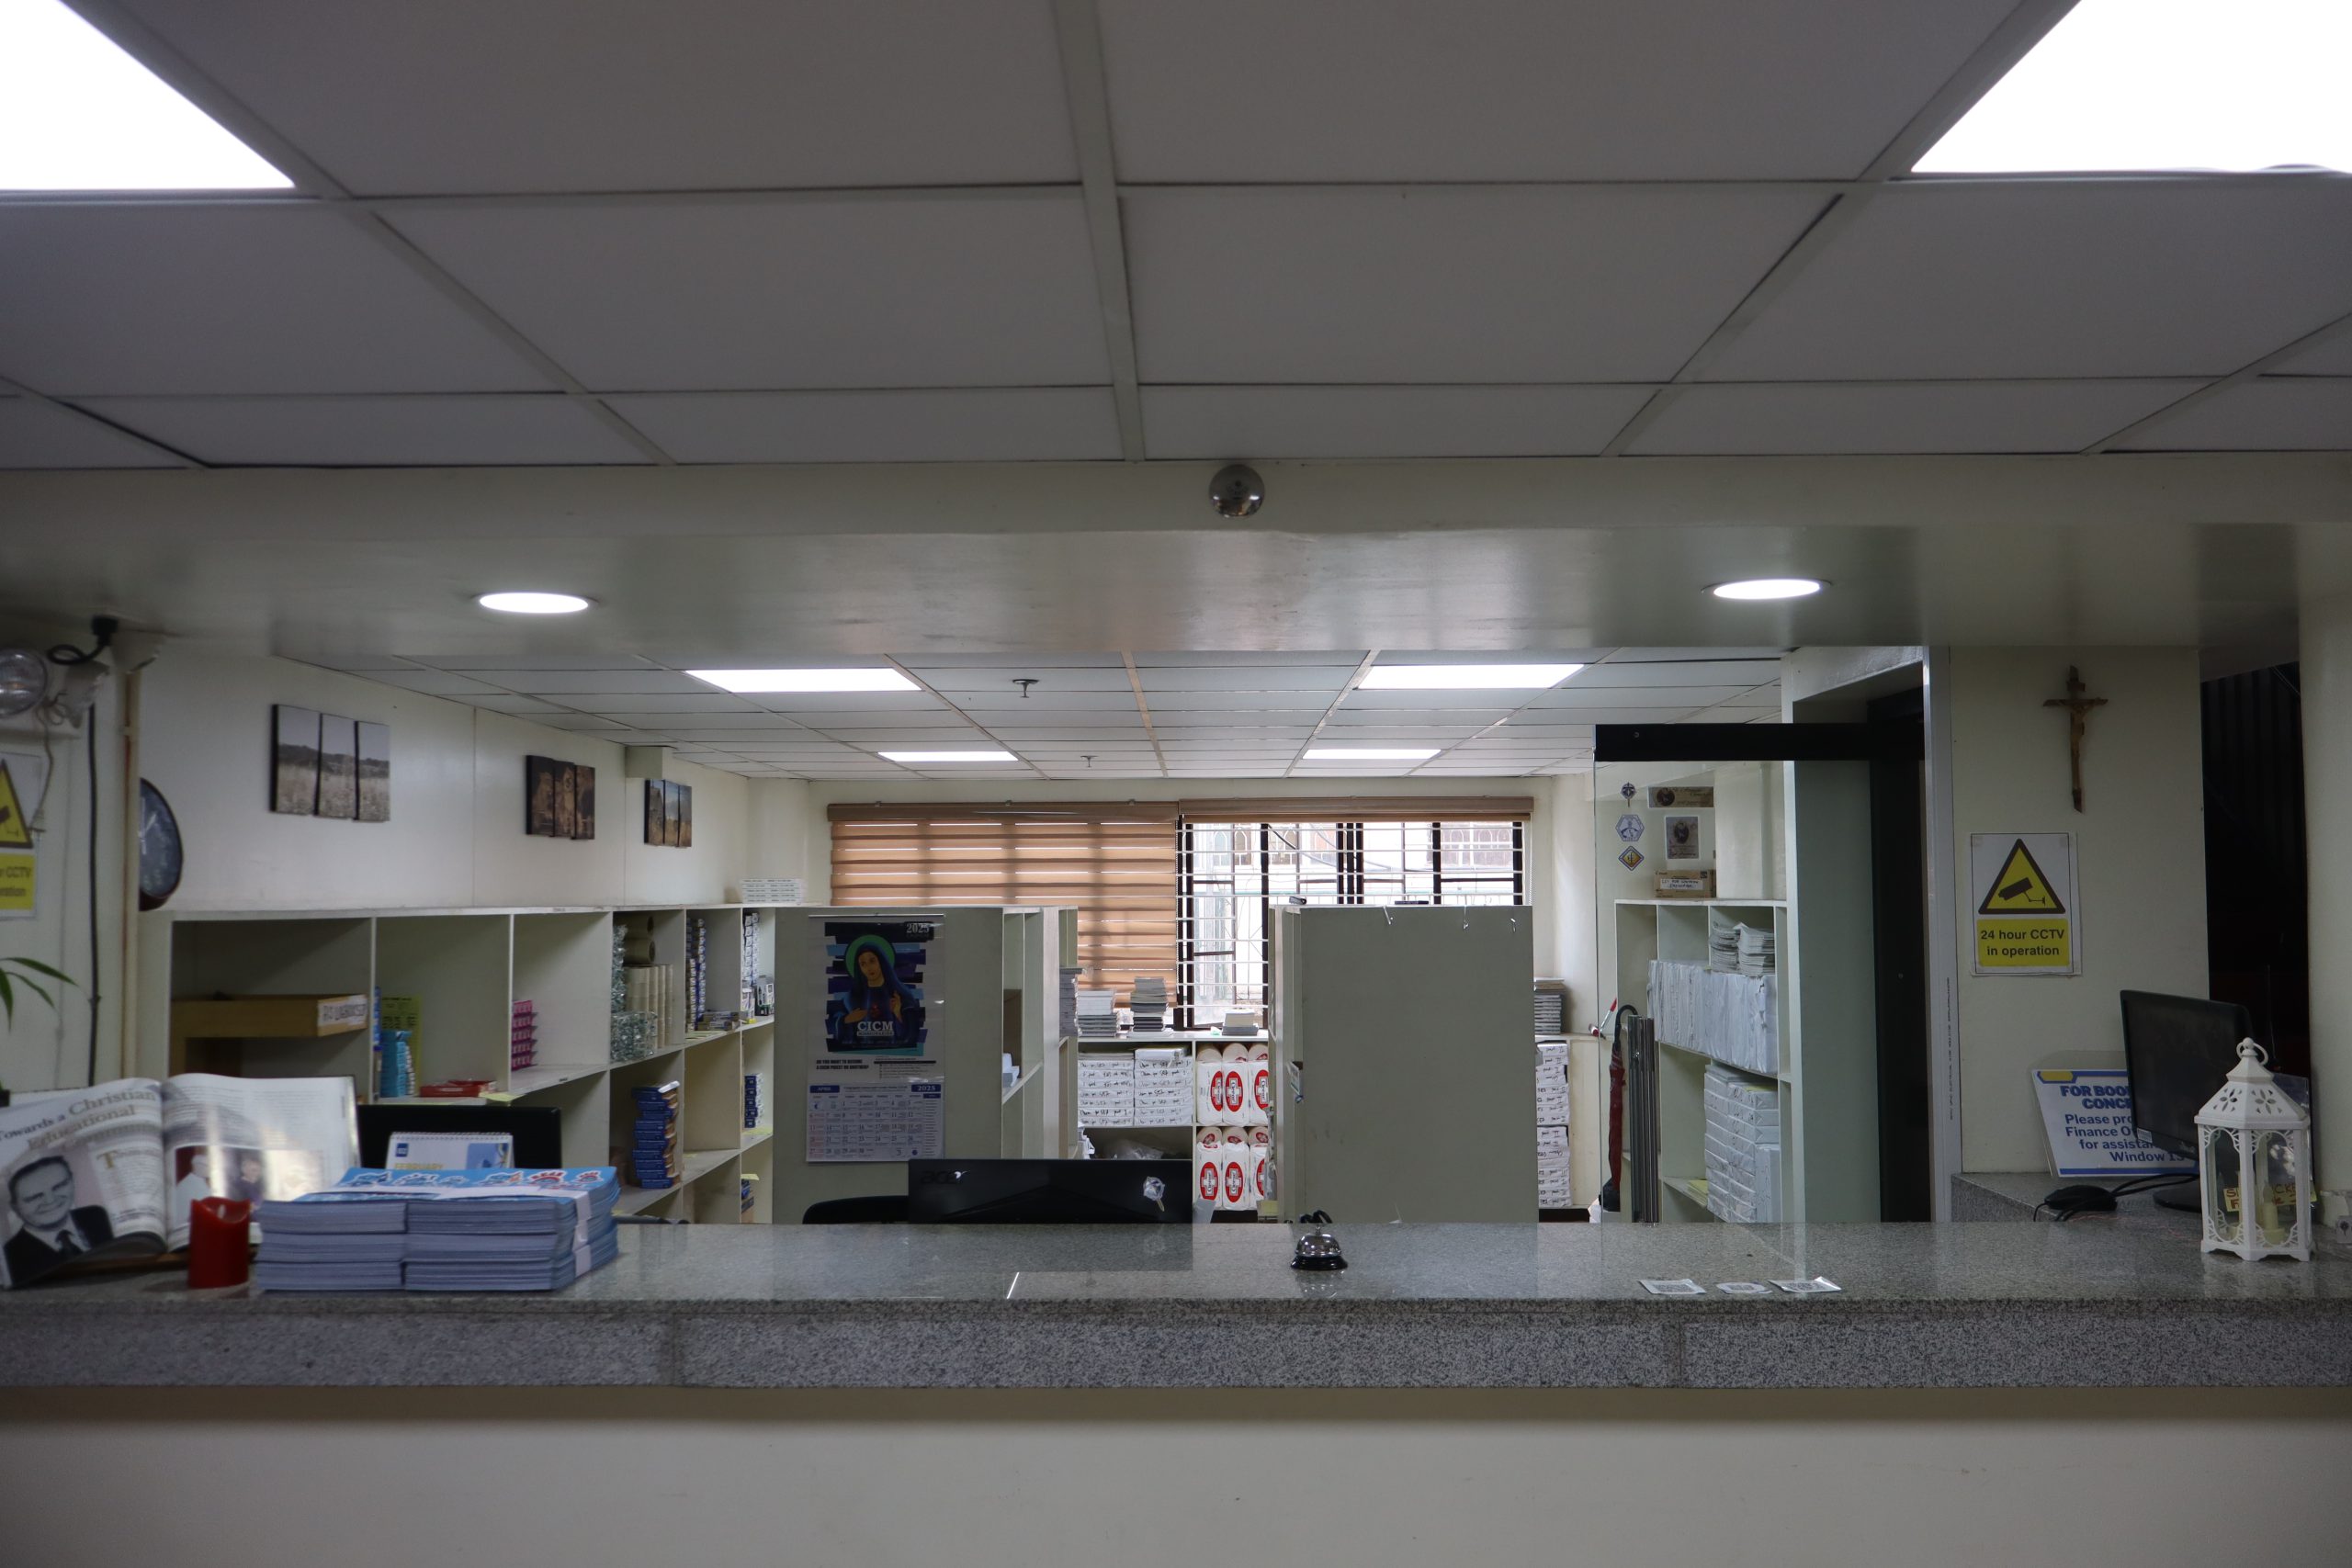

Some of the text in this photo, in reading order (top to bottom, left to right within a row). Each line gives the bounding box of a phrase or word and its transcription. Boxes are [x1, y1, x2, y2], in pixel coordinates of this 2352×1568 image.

[906, 923, 929, 933] 2025
[1981, 929, 2065, 939] 24 hour CCTV
[1987, 946, 2059, 958] in operation
[857, 1021, 893, 1031] CICM
[2060, 1085, 2092, 1096] FOR
[68, 1089, 156, 1115] Christian
[2065, 1114, 2110, 1124] Please
[28, 1105, 136, 1150] Educational
[2065, 1126, 2118, 1137] Finance
[2079, 1139, 2098, 1149] for
[2109, 1151, 2165, 1162] Window
